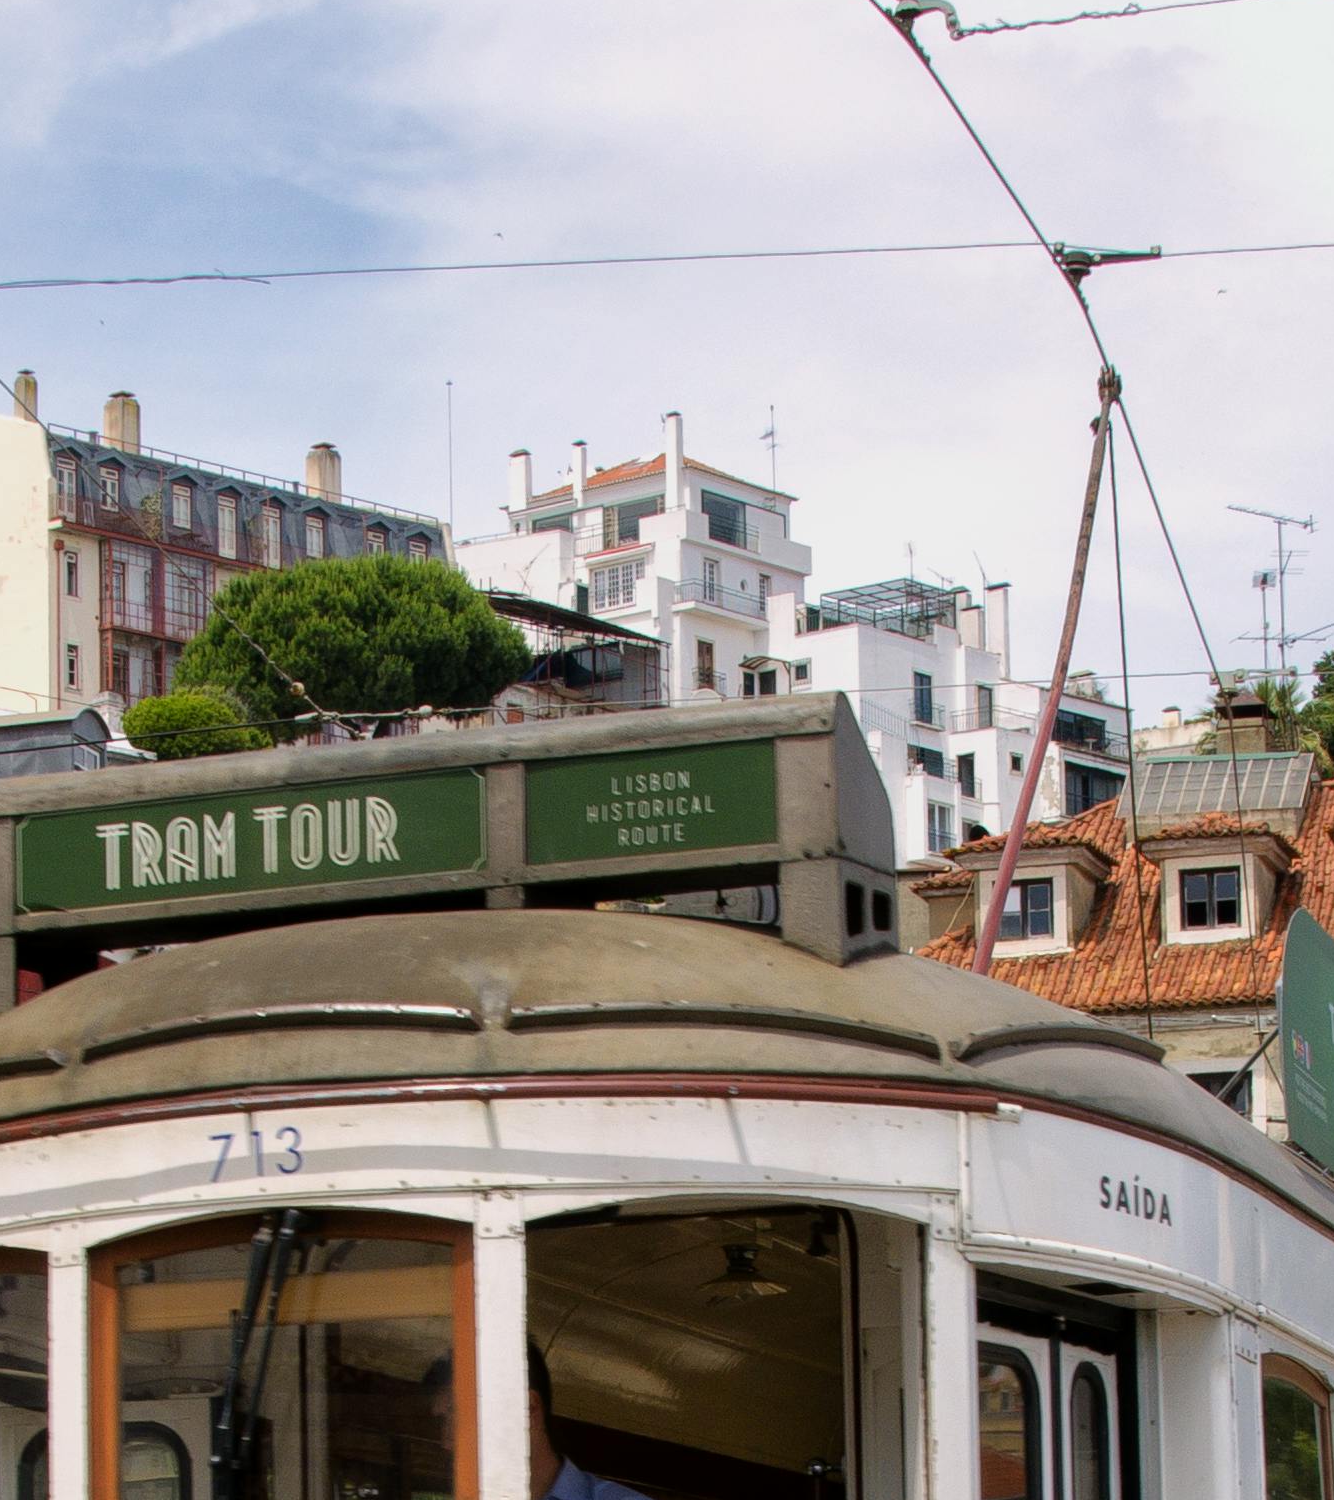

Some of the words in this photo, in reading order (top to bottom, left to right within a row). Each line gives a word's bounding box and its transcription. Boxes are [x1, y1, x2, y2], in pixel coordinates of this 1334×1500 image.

[610, 770, 691, 796] LISBON
[585, 795, 716, 824] HISTORICAL
[95, 811, 236, 890] TRAM
[252, 796, 401, 873] TOUR
[617, 822, 686, 847] ROUTE
[209, 1126, 303, 1183] 713
[1099, 1174, 1172, 1227] SAÍDA
